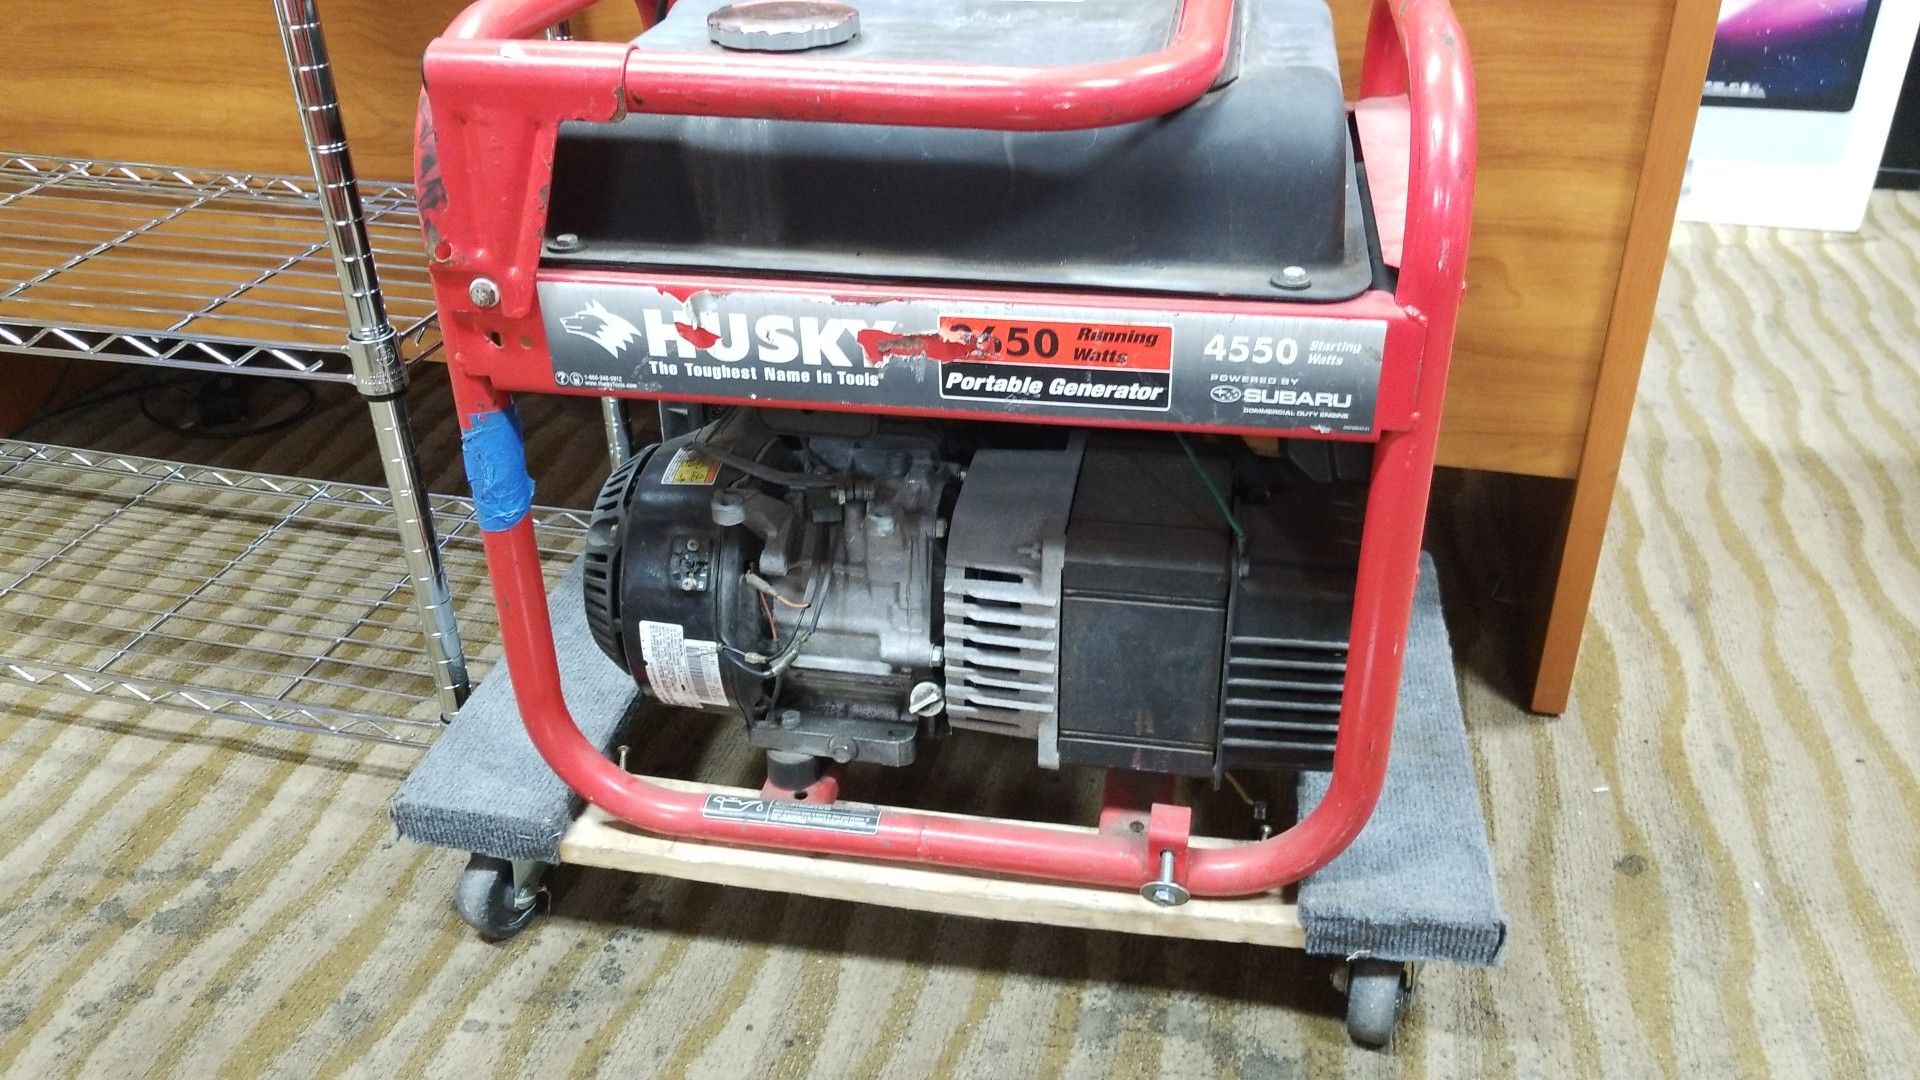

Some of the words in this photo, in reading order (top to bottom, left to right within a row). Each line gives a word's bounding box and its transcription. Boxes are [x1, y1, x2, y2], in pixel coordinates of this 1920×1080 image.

[1077, 327, 1159, 347] Running
[1203, 334, 1298, 365] 4550
[1309, 340, 1362, 354] Starting
[1073, 348, 1129, 365] Watts
[1307, 353, 1343, 366] Watts
[649, 360, 678, 376] The
[684, 362, 757, 381] Toughest
[764, 367, 810, 384] Name
[816, 369, 832, 384] In
[836, 371, 879, 387] Tools
[1210, 374, 1277, 385] POWERED
[1280, 376, 1299, 386] BY
[946, 372, 1044, 395] Portable
[1049, 378, 1164, 401] Generator
[1243, 388, 1352, 408] SUBARU
[1243, 407, 1295, 417] COMMERCIAL
[1296, 410, 1318, 418] DUTY
[1319, 411, 1349, 420] ENGINE
